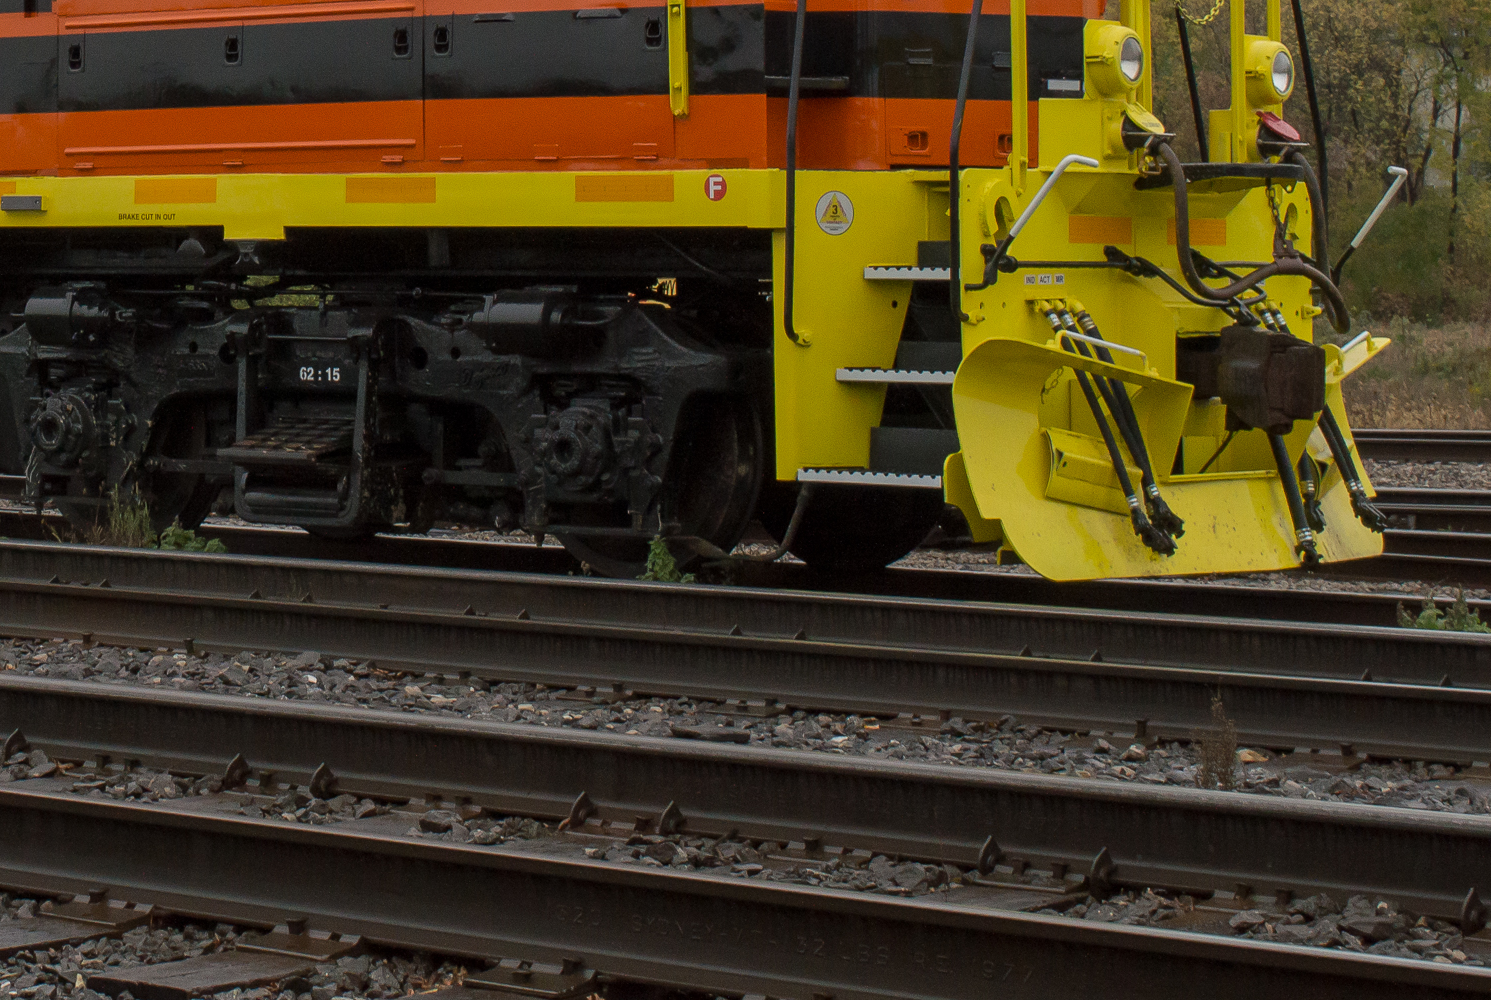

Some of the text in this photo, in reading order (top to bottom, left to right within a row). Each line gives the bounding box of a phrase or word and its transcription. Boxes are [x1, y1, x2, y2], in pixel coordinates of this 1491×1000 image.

[709, 176, 723, 199] F
[832, 204, 838, 215] 3
[118, 213, 176, 221] BRAKE CUT IN OUT
[1039, 275, 1051, 284] ACT
